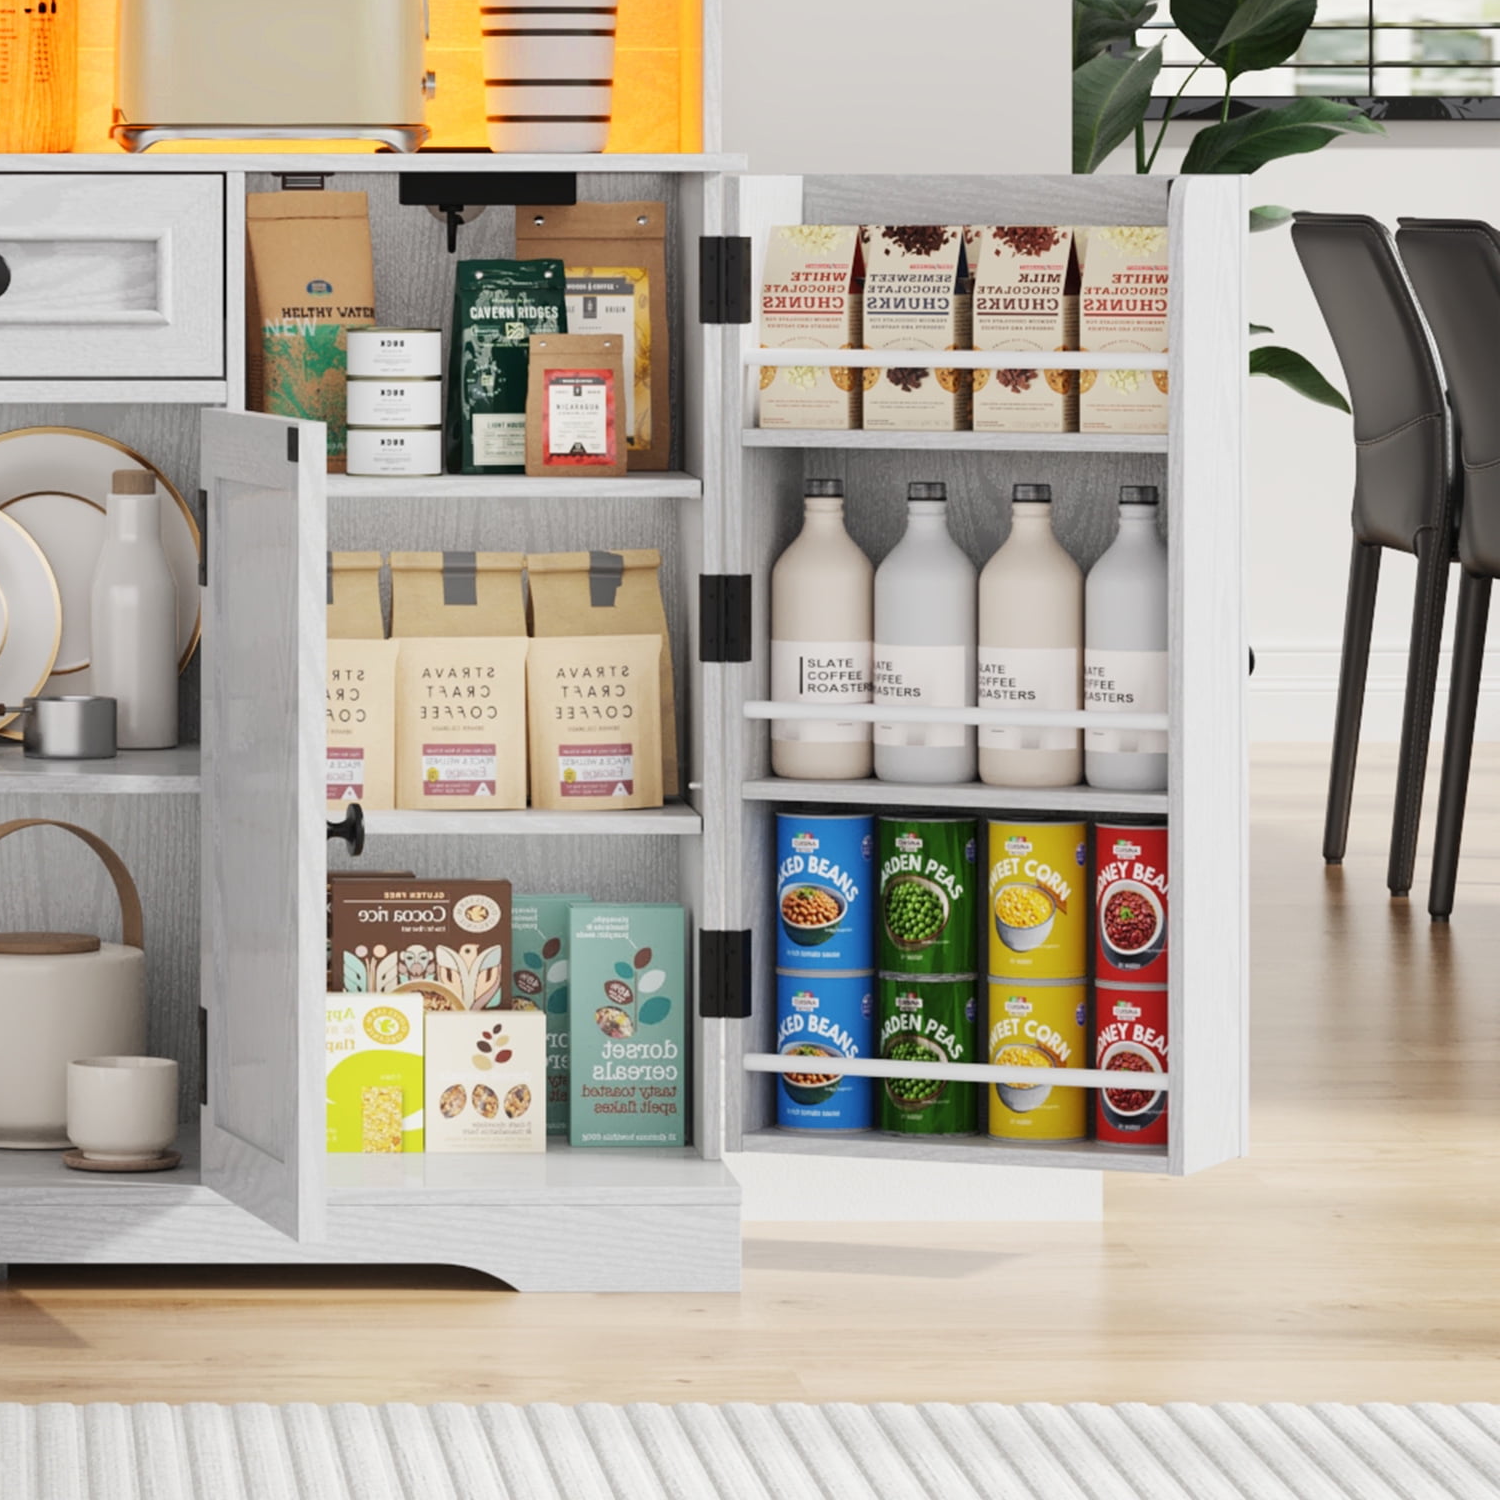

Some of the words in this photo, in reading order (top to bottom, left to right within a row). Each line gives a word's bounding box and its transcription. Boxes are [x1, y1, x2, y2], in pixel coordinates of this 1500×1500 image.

[282, 307, 332, 318] HELTHY
[470, 306, 514, 319] CAVERN
[517, 306, 558, 319] RIDGES
[265, 317, 317, 337] NEW
[807, 658, 853, 668] SLATE
[875, 661, 893, 671] ATE
[807, 671, 862, 681] COFFEE
[1085, 666, 1105, 677] ATE
[874, 686, 921, 697] ASTERS
[807, 856, 859, 902] BEANS
[925, 858, 963, 900] PEAS
[1024, 860, 1071, 901] CORN
[807, 1014, 859, 1059] BEANS
[925, 1018, 963, 1059] PEAS
[1024, 1020, 1071, 1061] CORN
